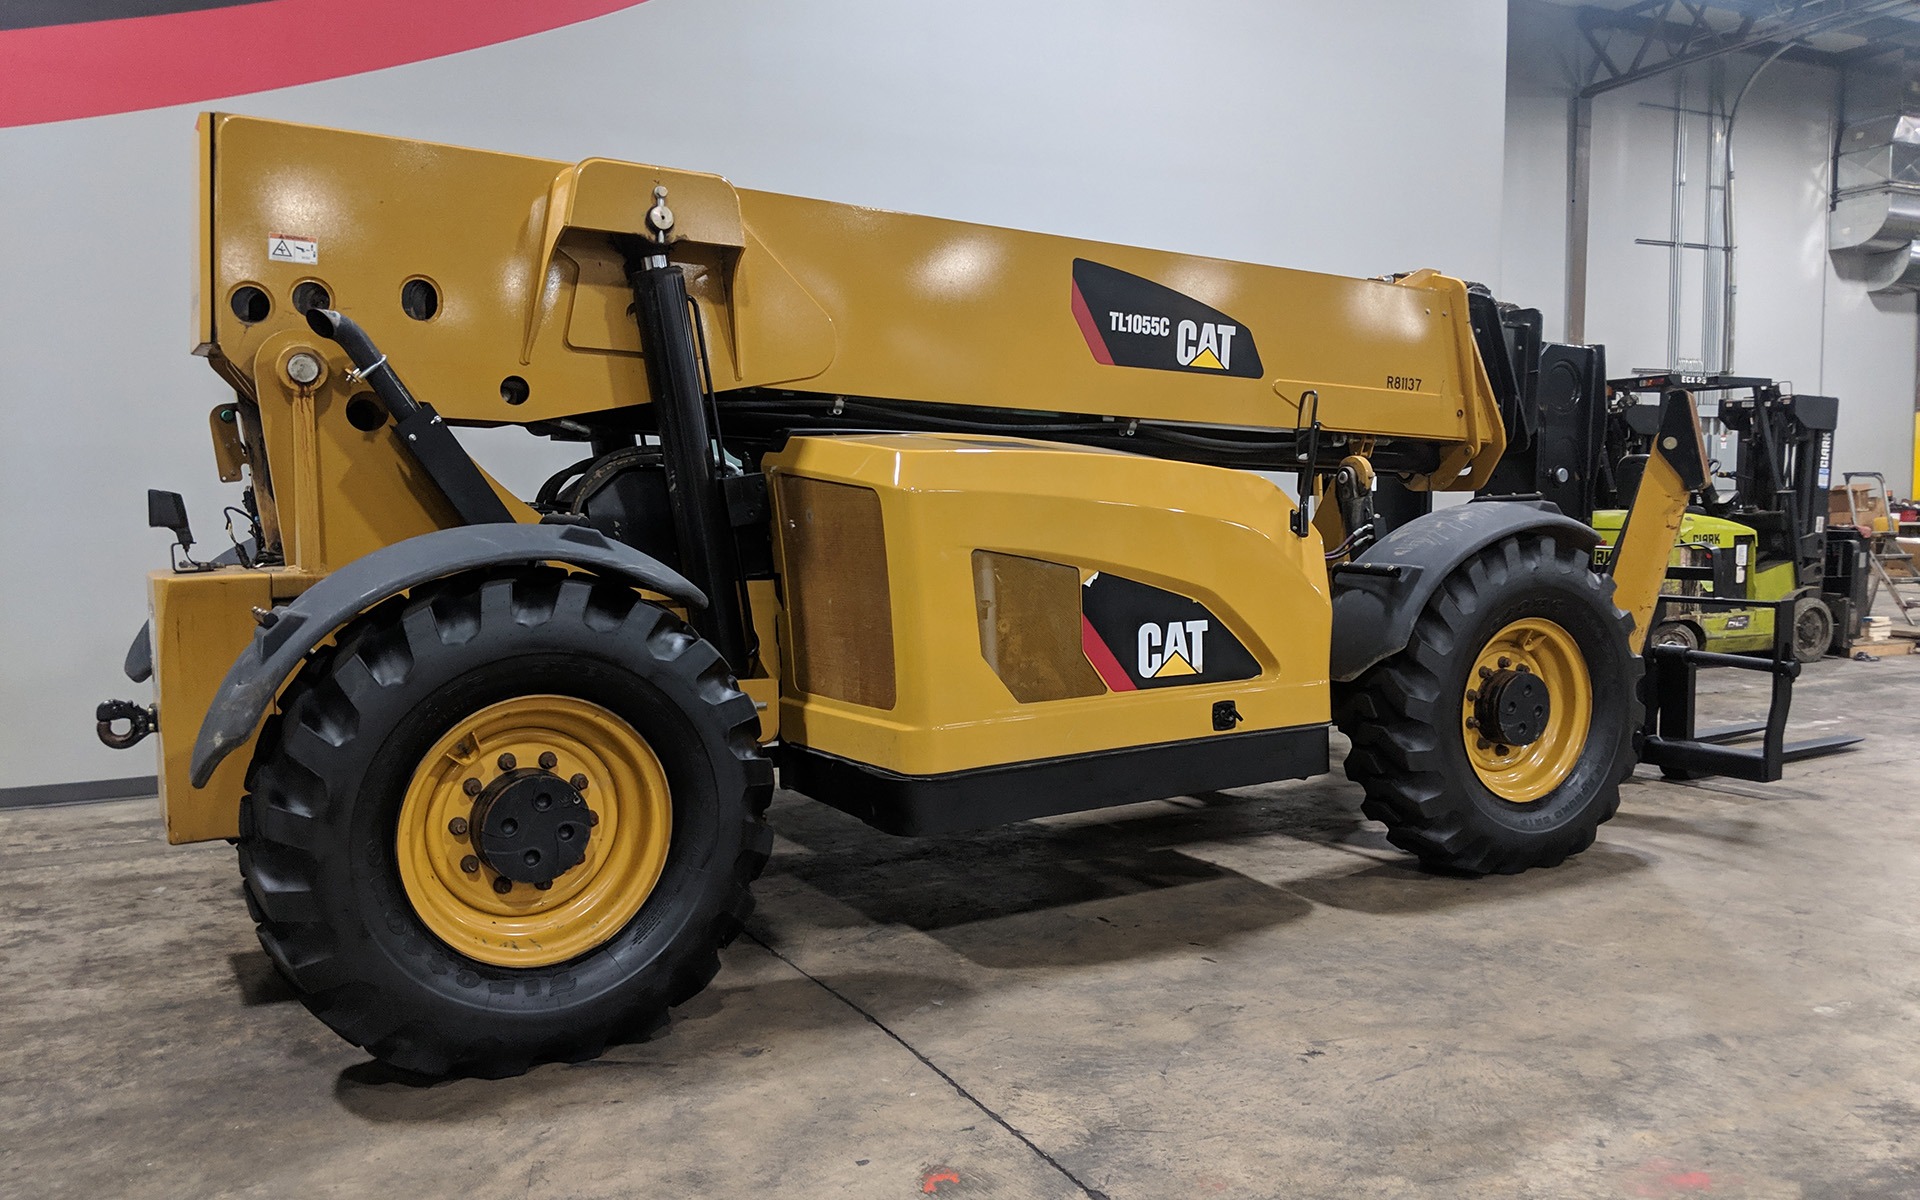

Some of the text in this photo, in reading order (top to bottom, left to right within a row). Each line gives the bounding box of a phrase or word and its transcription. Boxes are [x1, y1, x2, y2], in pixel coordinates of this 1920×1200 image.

[1109, 311, 1170, 337] TL1055C
[1176, 319, 1237, 371] CAT
[1386, 375, 1422, 391] R81137
[1820, 432, 1831, 468] CLARK
[1138, 619, 1209, 679] CAT
